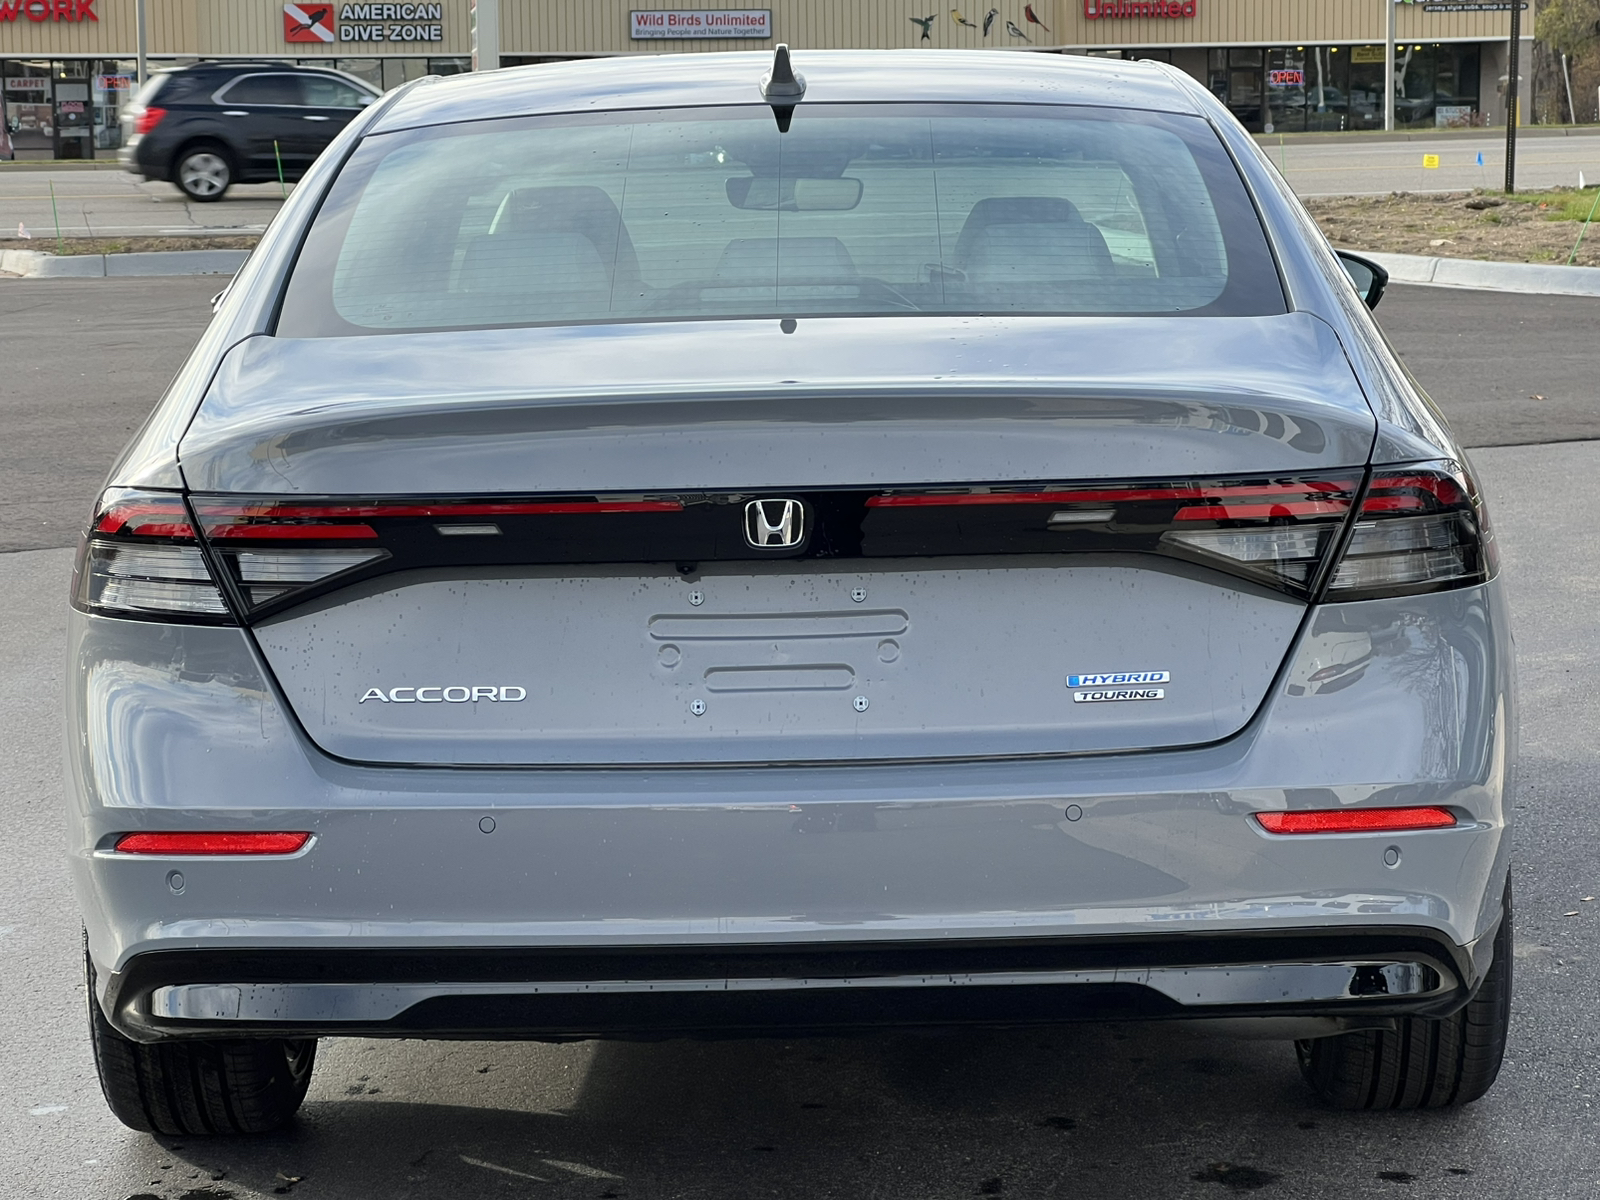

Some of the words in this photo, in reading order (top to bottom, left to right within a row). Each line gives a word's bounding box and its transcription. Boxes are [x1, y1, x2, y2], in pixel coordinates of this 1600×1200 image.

[339, 3, 442, 20] AMERICAN
[1084, 0, 1196, 19] Unlimited
[636, 14, 664, 26] Wild
[668, 14, 702, 26] Birds
[705, 14, 765, 26] Unlimited
[339, 25, 384, 41] DIVE
[389, 25, 442, 41] ZONE
[635, 28, 666, 37] Bringing
[667, 28, 691, 36] People
[733, 28, 765, 36] Together
[10, 79, 45, 89] CARPET
[97, 76, 131, 89] OPEN
[1271, 71, 1303, 85] OPEN
[1082, 673, 1164, 684] HYBRID
[359, 686, 527, 704] ACCORD
[1080, 689, 1159, 700] TOURING
